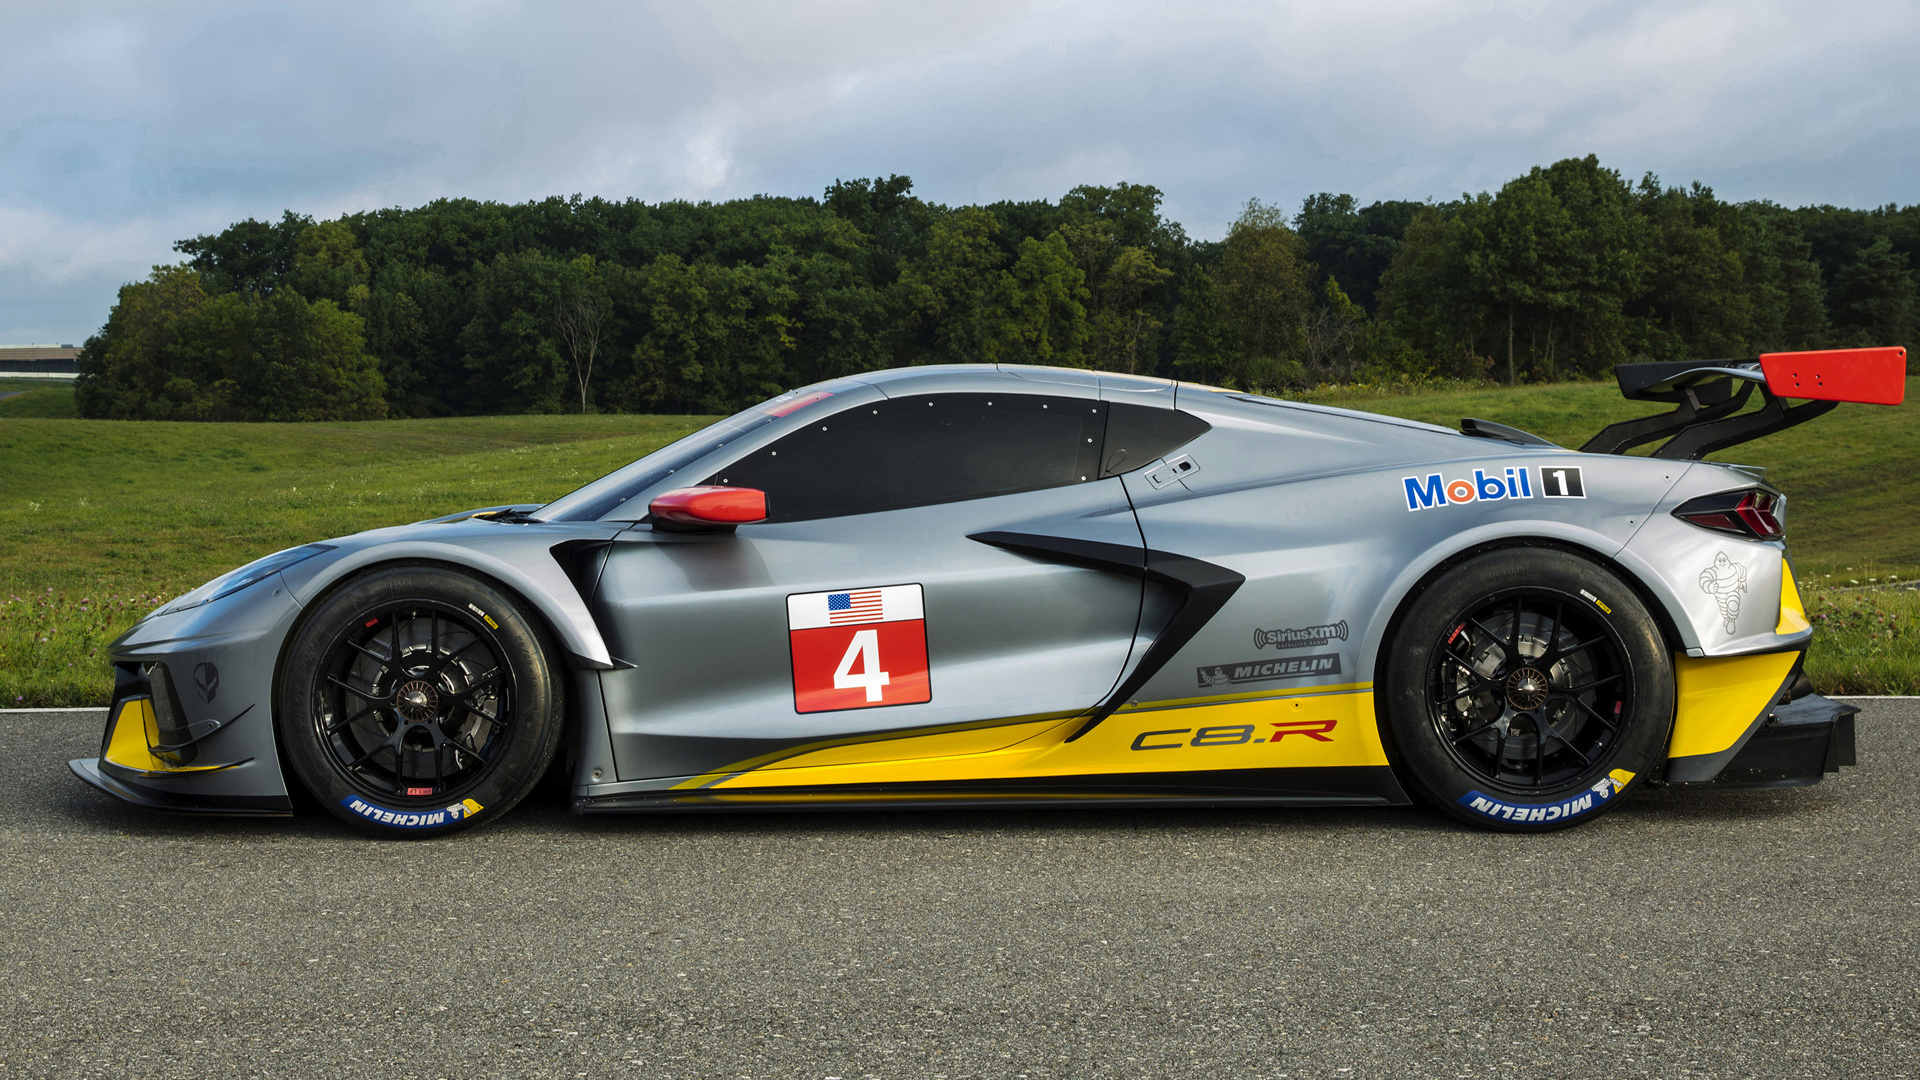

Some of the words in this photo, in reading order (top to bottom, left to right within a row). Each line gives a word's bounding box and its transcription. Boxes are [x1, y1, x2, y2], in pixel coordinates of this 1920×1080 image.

[1402, 466, 1534, 512] Mobil
[833, 629, 890, 702] 4
[1233, 657, 1334, 679] MICHELIN
[1130, 719, 1338, 751] C8.R
[349, 799, 445, 826] MICHELIN
[1470, 793, 1593, 822] MICHELIN
